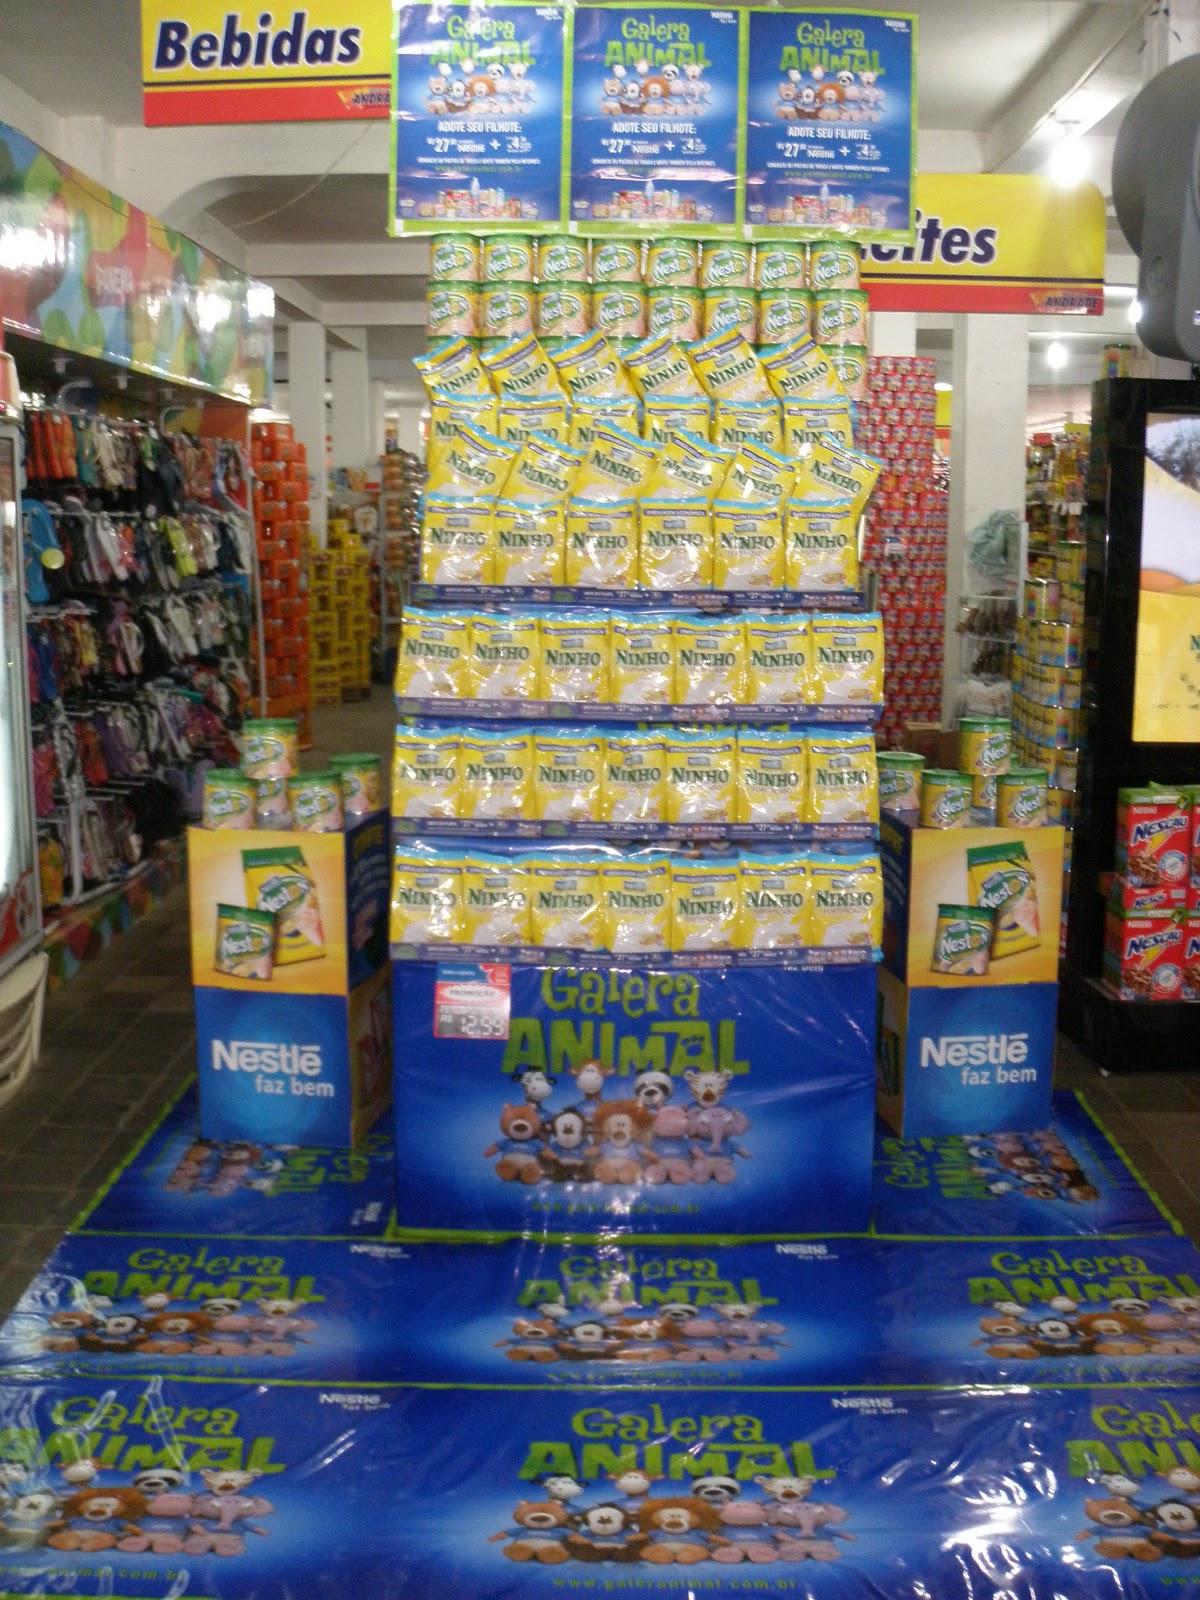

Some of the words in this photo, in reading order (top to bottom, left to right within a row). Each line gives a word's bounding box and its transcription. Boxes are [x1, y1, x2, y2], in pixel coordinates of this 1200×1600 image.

[621, 14, 690, 42] Galera
[796, 20, 866, 48] Galera
[154, 11, 361, 70] Bebidas
[604, 41, 712, 67] ANIMAL
[779, 46, 886, 75] ANIMAL
[437, 121, 465, 132] ADOTE
[466, 121, 483, 132] SEU
[612, 122, 640, 133] ADOTE
[641, 122, 658, 133] SEU
[787, 126, 815, 138] ADOTE
[816, 127, 833, 139] SEU
[1045, 296, 1097, 308] ANDRADE
[502, 363, 549, 392] NINHO
[706, 357, 755, 388] NINHO
[779, 361, 829, 392] NINHO
[592, 450, 641, 483] NINHO
[811, 460, 862, 493] NINHO
[500, 531, 554, 548] NINHO
[648, 530, 704, 547] NINHO
[793, 532, 848, 549] NINHO
[406, 639, 460, 660] NINHO
[476, 643, 530, 661] NINHO
[546, 649, 601, 666] NINHO
[616, 648, 671, 665] NINHO
[681, 649, 736, 666] NINHO
[751, 650, 806, 667] NINHO
[819, 647, 875, 663] NINHO
[540, 765, 595, 783] NINHO
[608, 765, 661, 782] NINHO
[671, 767, 730, 784] NINHO
[816, 768, 869, 785] NINHO
[1130, 816, 1189, 847] NESCAU
[539, 891, 594, 909] NINHO
[608, 890, 664, 908] NINHO
[816, 890, 874, 907] NINHO
[1124, 929, 1184, 960] NESCAU
[541, 968, 700, 1019] Galera
[211, 1039, 323, 1076] Nestlé
[500, 1018, 750, 1075] ANIMAL
[920, 1032, 1029, 1067] Nestlé
[255, 1074, 285, 1095] faz
[290, 1075, 335, 1097] bem
[961, 1067, 990, 1086] faz
[996, 1065, 1037, 1085] bem
[775, 1243, 828, 1256] Nestlé
[127, 1248, 286, 1275] Galera
[559, 1252, 720, 1280] Galera
[990, 1250, 1151, 1277] Galera
[72, 1270, 326, 1302] ANIMAL
[517, 1278, 779, 1307] ANIMAL
[831, 1397, 894, 1408] Nestlé
[51, 1395, 239, 1436] Galera
[571, 1404, 764, 1443] Galera
[517, 1440, 838, 1481] ANIMAL
